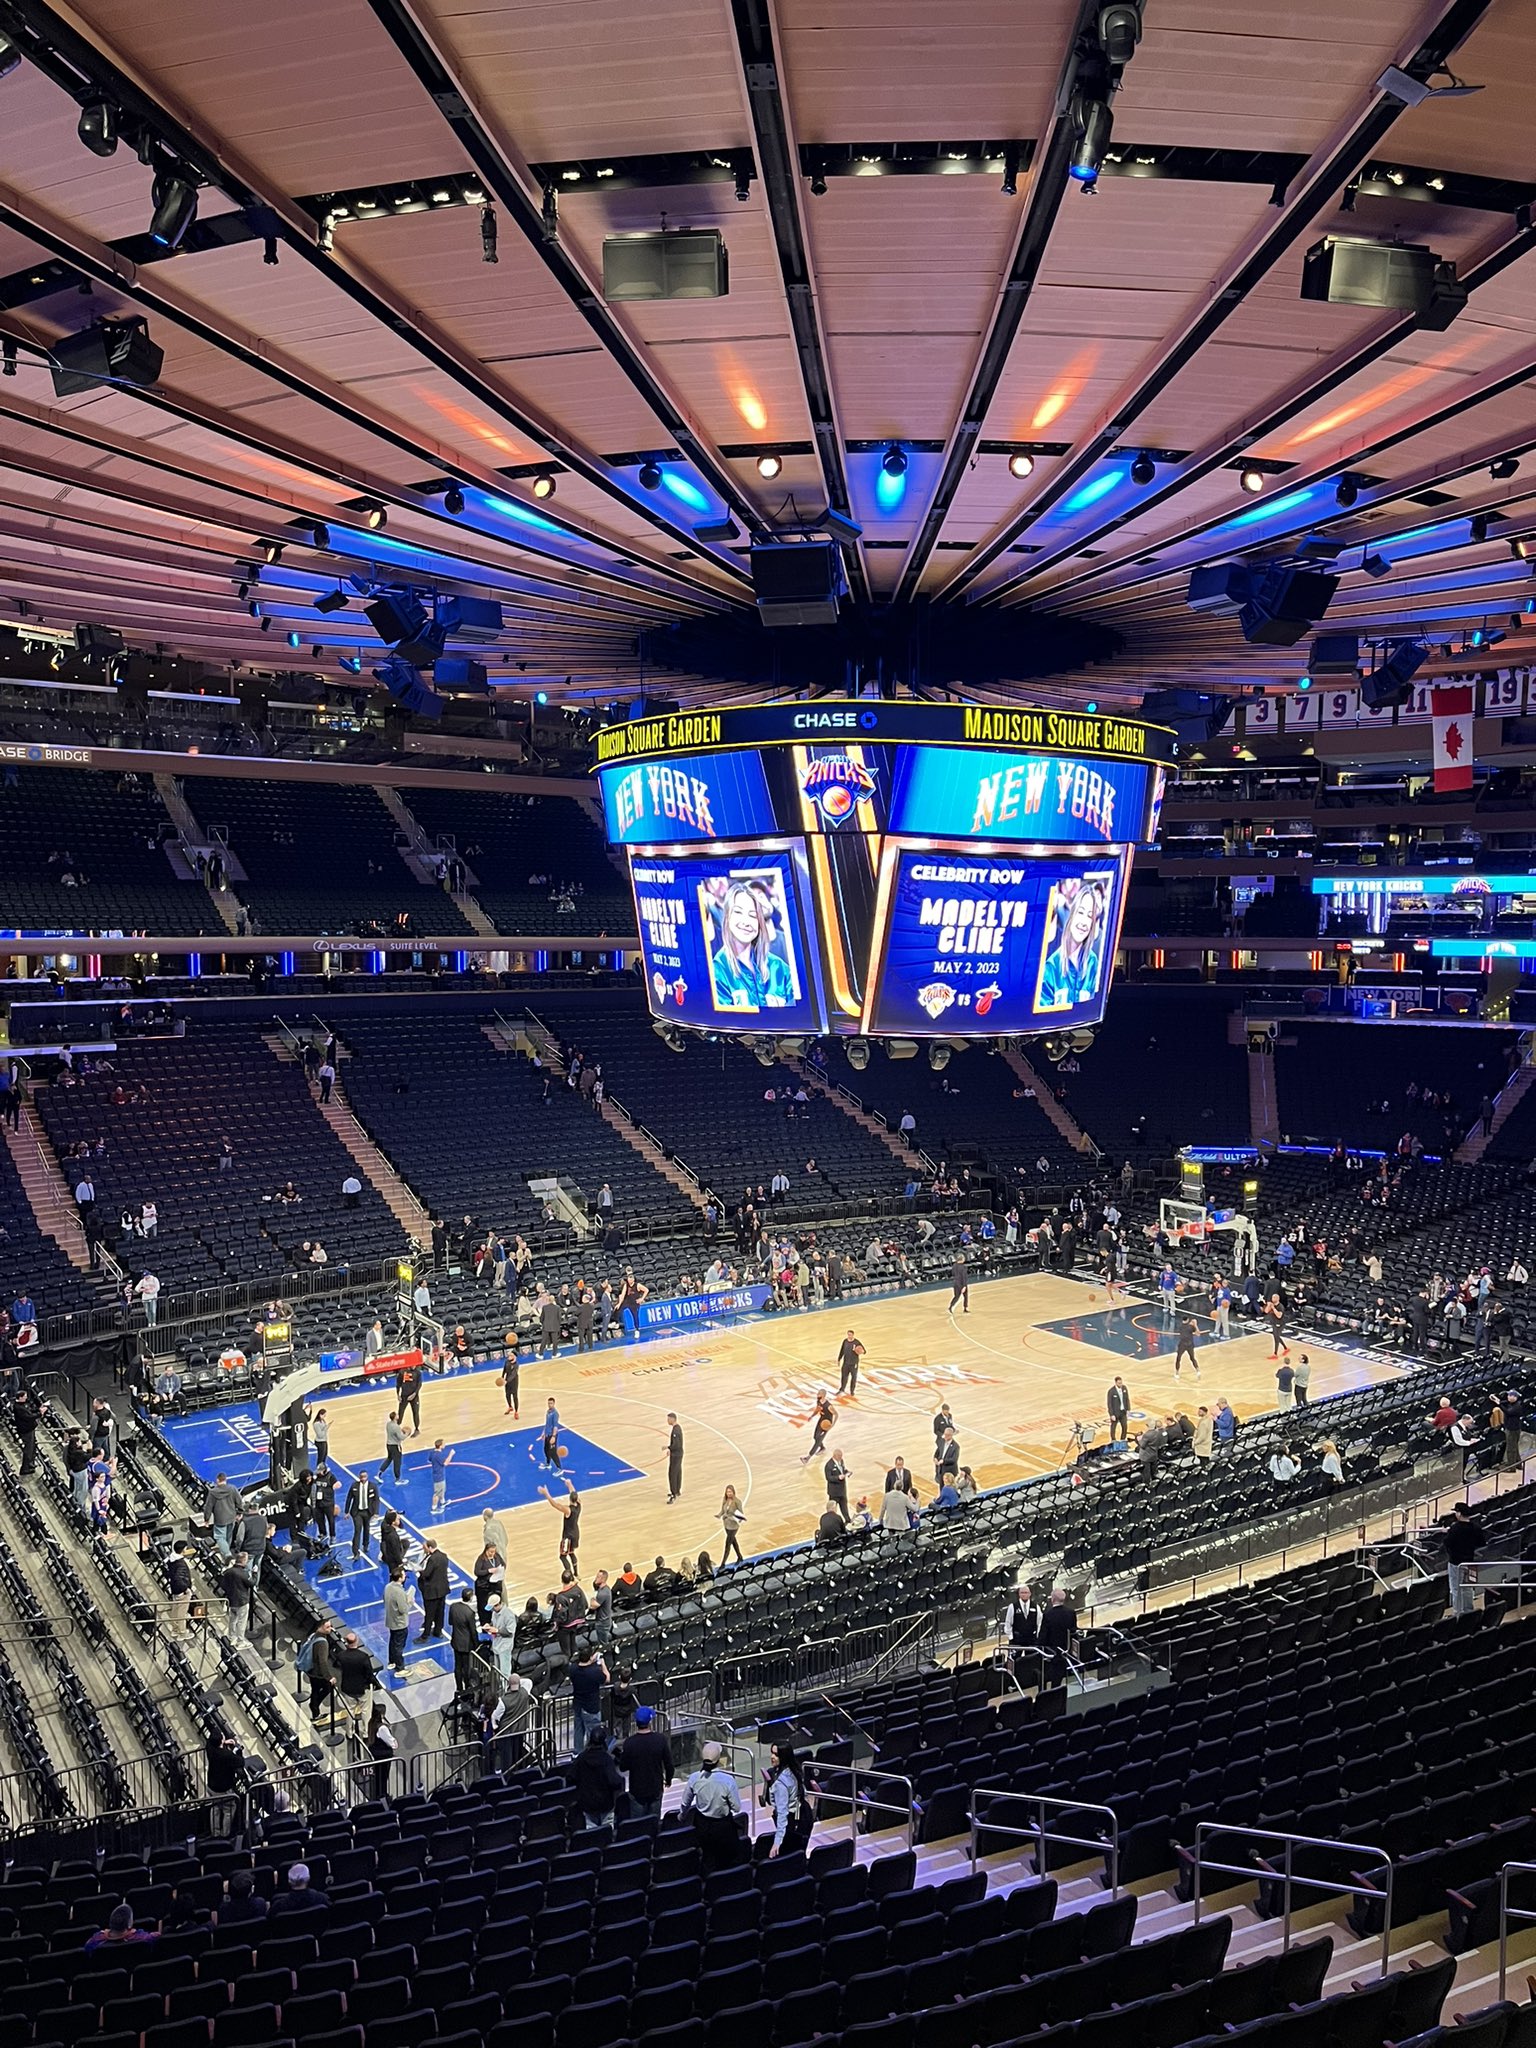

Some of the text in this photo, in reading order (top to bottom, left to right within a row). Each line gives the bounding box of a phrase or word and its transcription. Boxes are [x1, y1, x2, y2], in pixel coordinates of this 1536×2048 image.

[1490, 679, 1517, 705] 19
[1255, 699, 1269, 722] 3
[1294, 697, 1310, 720] 7
[1333, 694, 1347, 718] 9
[794, 713, 857, 729] CHASE
[965, 708, 1145, 754] MADISON SQUARE GARDEN
[627, 724, 665, 753] SQUARE
[668, 715, 721, 746] GARDEN
[45, 749, 89, 761] BRIDGE
[804, 760, 877, 789] KNICKS
[615, 765, 716, 840] NEW YORK
[971, 761, 1117, 841] NEW YORK
[911, 865, 1025, 885] CELEBRITY ROW
[1334, 880, 1424, 892] NEW YORK KNICKS
[920, 898, 1028, 928] MADELYN
[331, 943, 376, 951] LEXUS
[937, 927, 1005, 955] CLINE
[933, 961, 1000, 975] MAY 2, 2023
[1347, 989, 1379, 1000] NEW
[647, 1304, 673, 1323] NEW
[675, 1299, 708, 1319] YORK
[1291, 1331, 1349, 1350] YORK
[1347, 1347, 1429, 1373] KNICKS
[631, 1360, 693, 1377] CHASE
